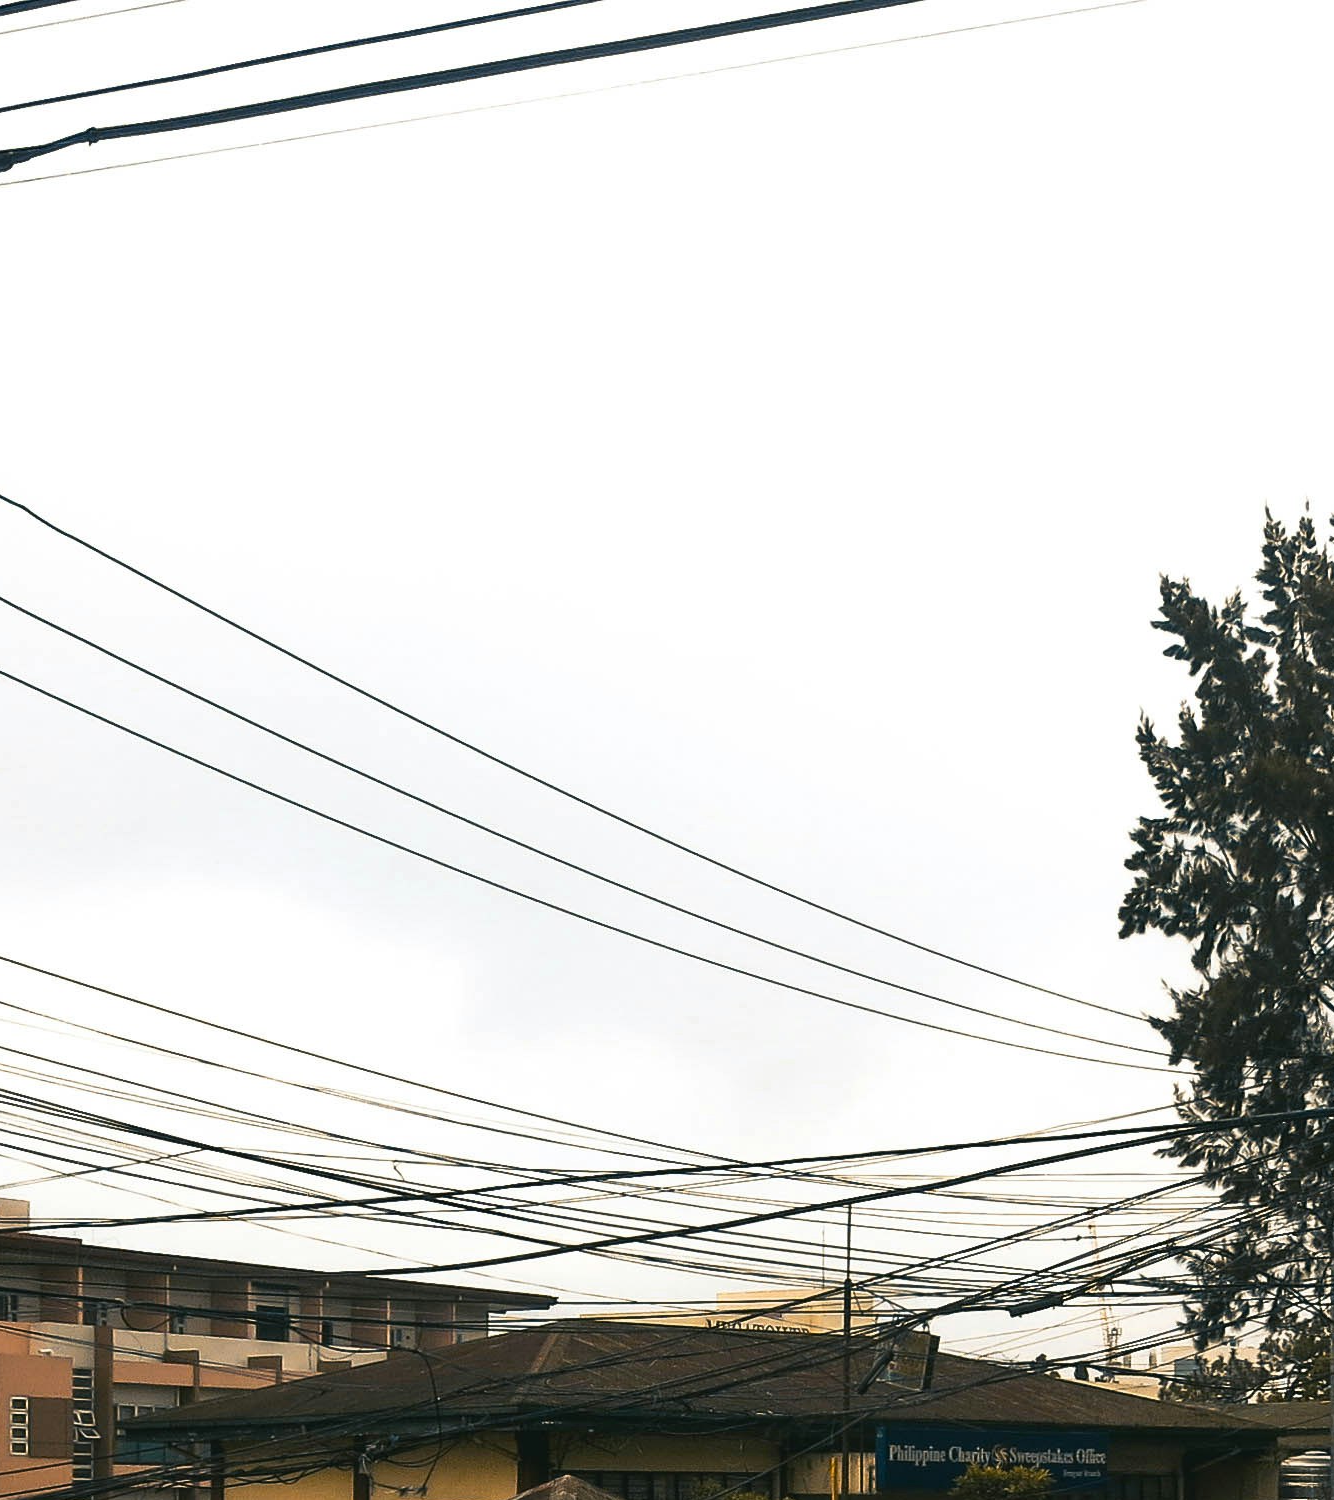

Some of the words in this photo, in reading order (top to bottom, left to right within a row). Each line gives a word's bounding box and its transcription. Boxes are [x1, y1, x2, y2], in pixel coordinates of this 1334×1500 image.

[889, 1445, 946, 1466] Philippine
[949, 1446, 990, 1467] Charity
[1076, 1448, 1106, 1464] Office
